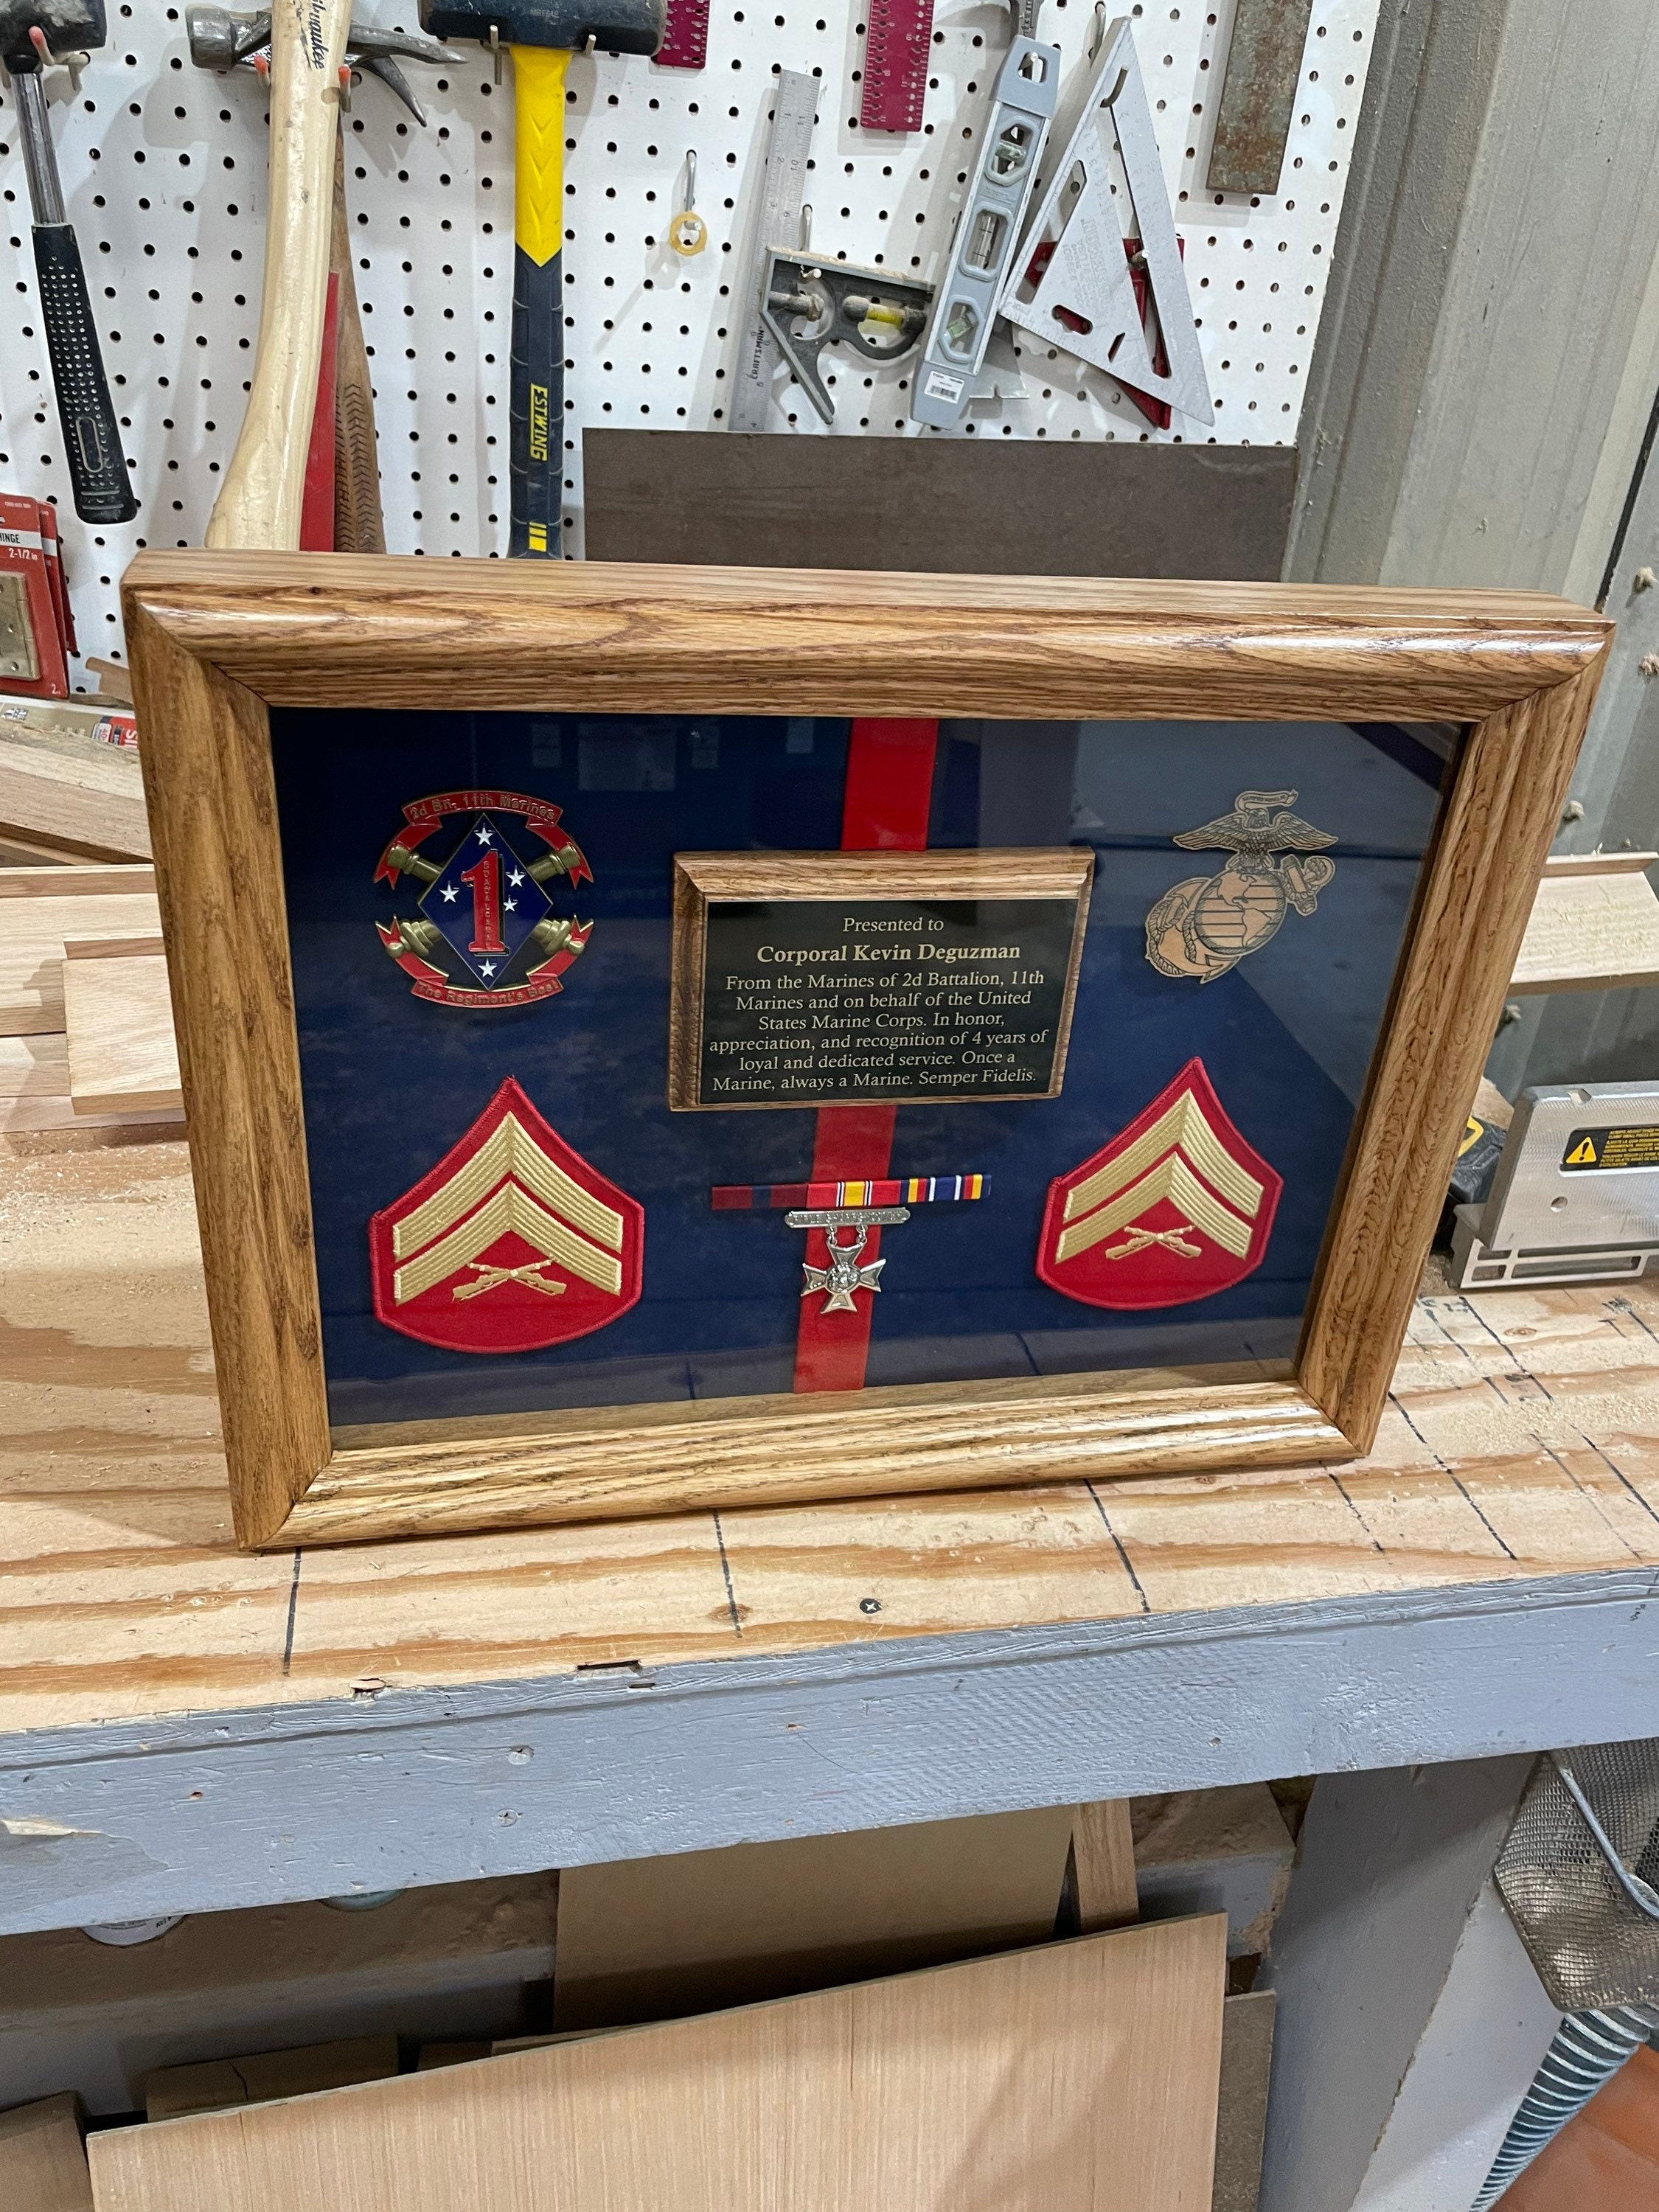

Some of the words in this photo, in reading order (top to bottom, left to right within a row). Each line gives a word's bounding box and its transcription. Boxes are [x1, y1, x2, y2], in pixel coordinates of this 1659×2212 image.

[745, 327, 765, 380] CRAFTSMAN
[529, 382, 549, 462] ESTWING
[410, 804, 428, 820] 2d
[462, 793, 495, 807] 11th
[499, 793, 556, 820] Marines
[843, 917, 922, 931] Presented
[928, 919, 944, 931] to
[757, 945, 846, 966] Corporal
[852, 945, 911, 960] Kevin
[917, 945, 1020, 963] Deguzman
[417, 982, 441, 998] The
[726, 976, 771, 990] From
[777, 975, 802, 989] the
[807, 974, 874, 988] Marines
[880, 973, 899, 987] of
[902, 973, 922, 986] 2d
[927, 971, 1004, 987] Battalion,
[1012, 970, 1043, 984] 11th
[736, 995, 803, 1010] Marines
[809, 995, 838, 1009] and
[844, 998, 863, 1008] on
[870, 992, 922, 1007] behalf
[925, 992, 944, 1006] of
[949, 992, 972, 1005] the
[979, 991, 1031, 1004] United
[759, 1017, 806, 1030] States
[812, 1015, 870, 1029] Marine
[876, 1014, 926, 1031] Corps.
[933, 1013, 949, 1026] In
[955, 1012, 1004, 1028] honor,
[710, 1036, 815, 1054] appreciation,
[821, 1034, 850, 1048] and
[855, 1033, 945, 1050] recognition
[950, 1032, 969, 1045] of
[972, 1032, 981, 1044] 4
[986, 1034, 1026, 1047] years
[1031, 1029, 1049, 1043] of
[740, 1057, 778, 1073] loyal
[784, 1056, 813, 1068] and
[818, 1053, 894, 1068] dedicated
[899, 1052, 955, 1065] service.
[962, 1051, 1002, 1063] Once
[1007, 1054, 1015, 1062] a
[713, 1077, 774, 1093] Marine,
[782, 1076, 833, 1091] always
[839, 1077, 847, 1086] a
[853, 1072, 912, 1086] Marine.
[919, 1071, 978, 1086] Semper
[981, 1068, 1035, 1082] Fidelis.
